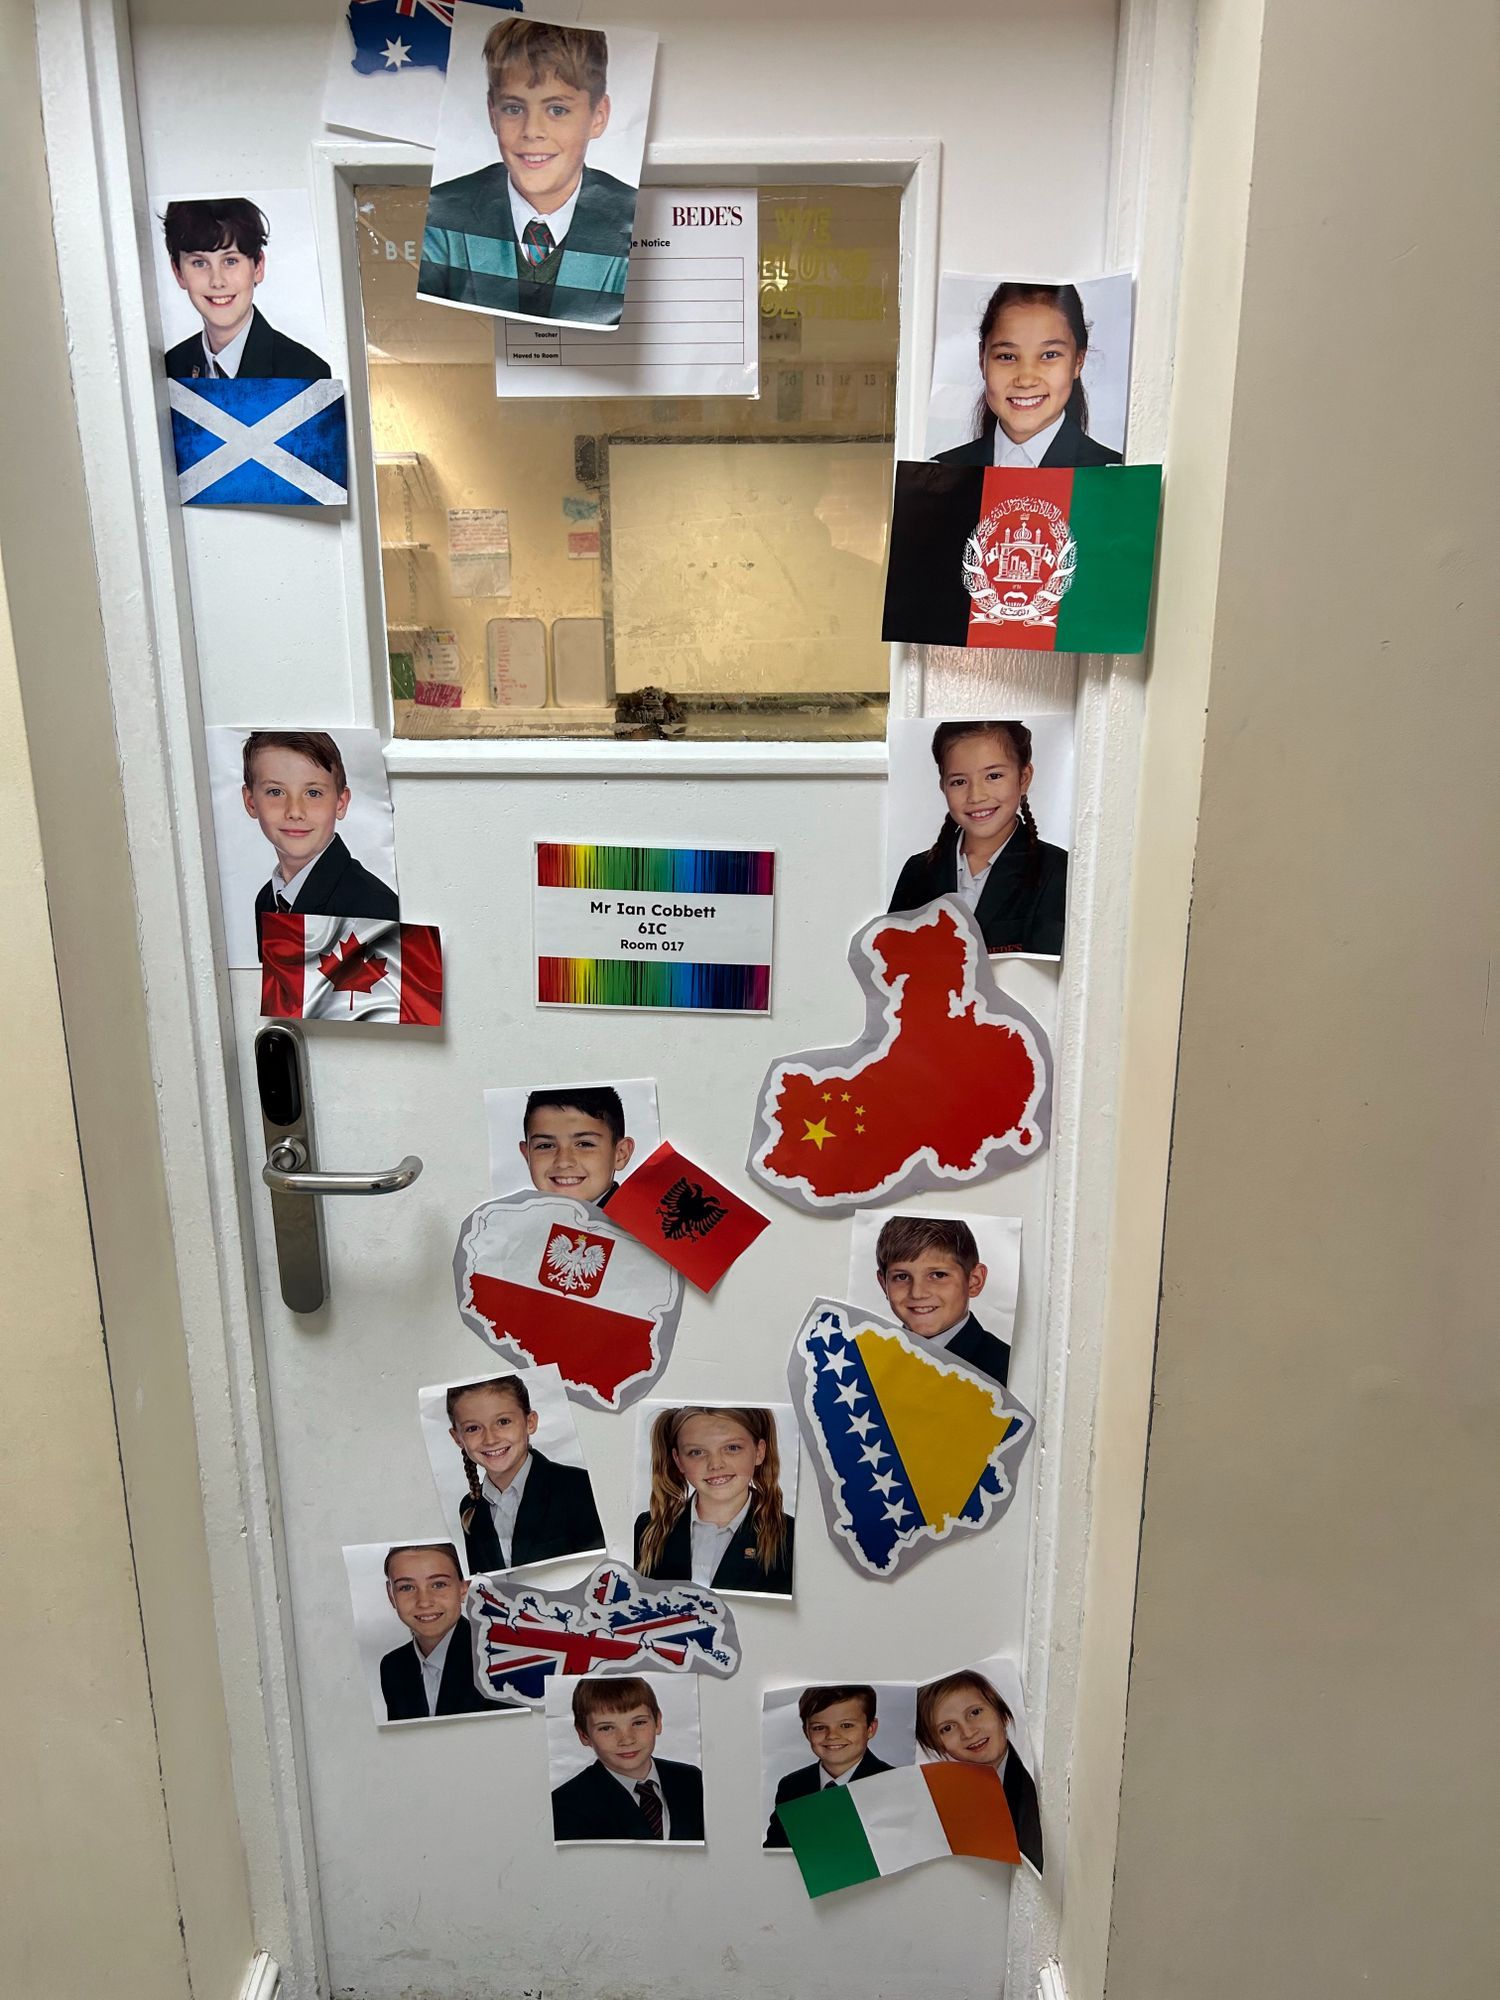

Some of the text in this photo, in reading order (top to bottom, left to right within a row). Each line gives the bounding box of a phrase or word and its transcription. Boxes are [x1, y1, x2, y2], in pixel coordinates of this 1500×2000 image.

[671, 206, 743, 227] BEDE'S
[640, 238, 671, 249] Notice
[590, 901, 716, 918] Mr Ian Cobbett
[638, 922, 667, 935] 6IC
[620, 939, 685, 951] Room 017
